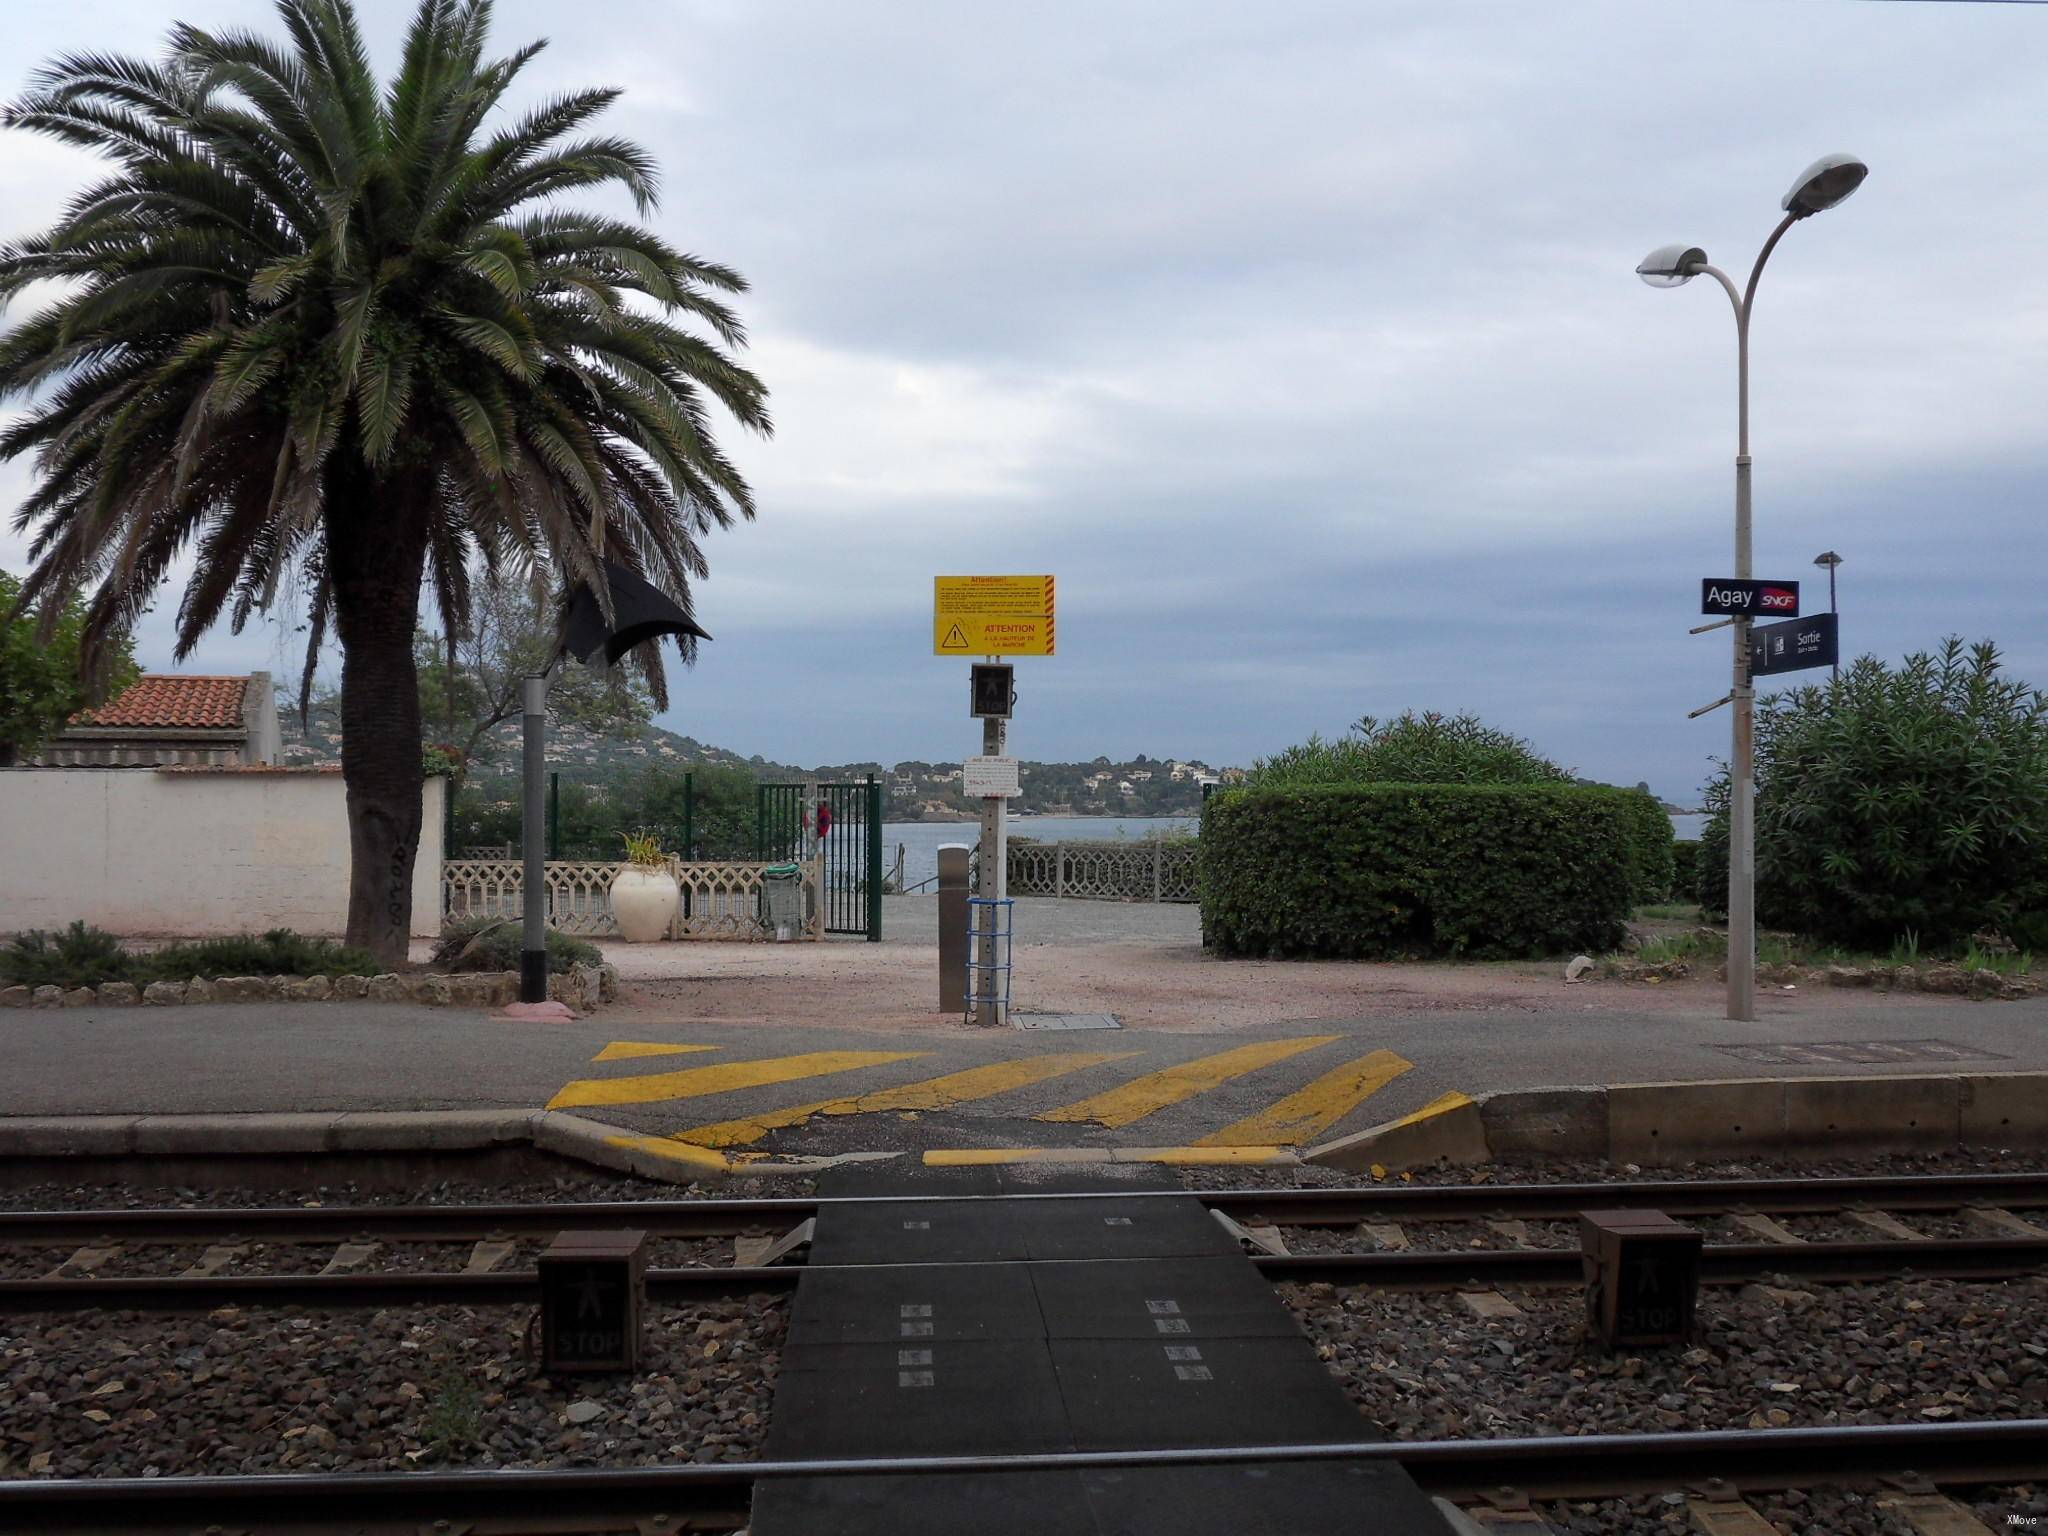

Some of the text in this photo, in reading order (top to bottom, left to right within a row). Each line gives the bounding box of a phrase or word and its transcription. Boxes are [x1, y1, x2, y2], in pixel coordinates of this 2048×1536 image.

[1707, 586, 1753, 608] Agay
[1760, 595, 1796, 607] SNCF
[984, 624, 1035, 633] ATTENTION
[1797, 630, 1821, 646] Sortie
[976, 702, 1007, 713] STOP
[1619, 1309, 1677, 1329] STOP
[559, 1331, 620, 1354] STOP
